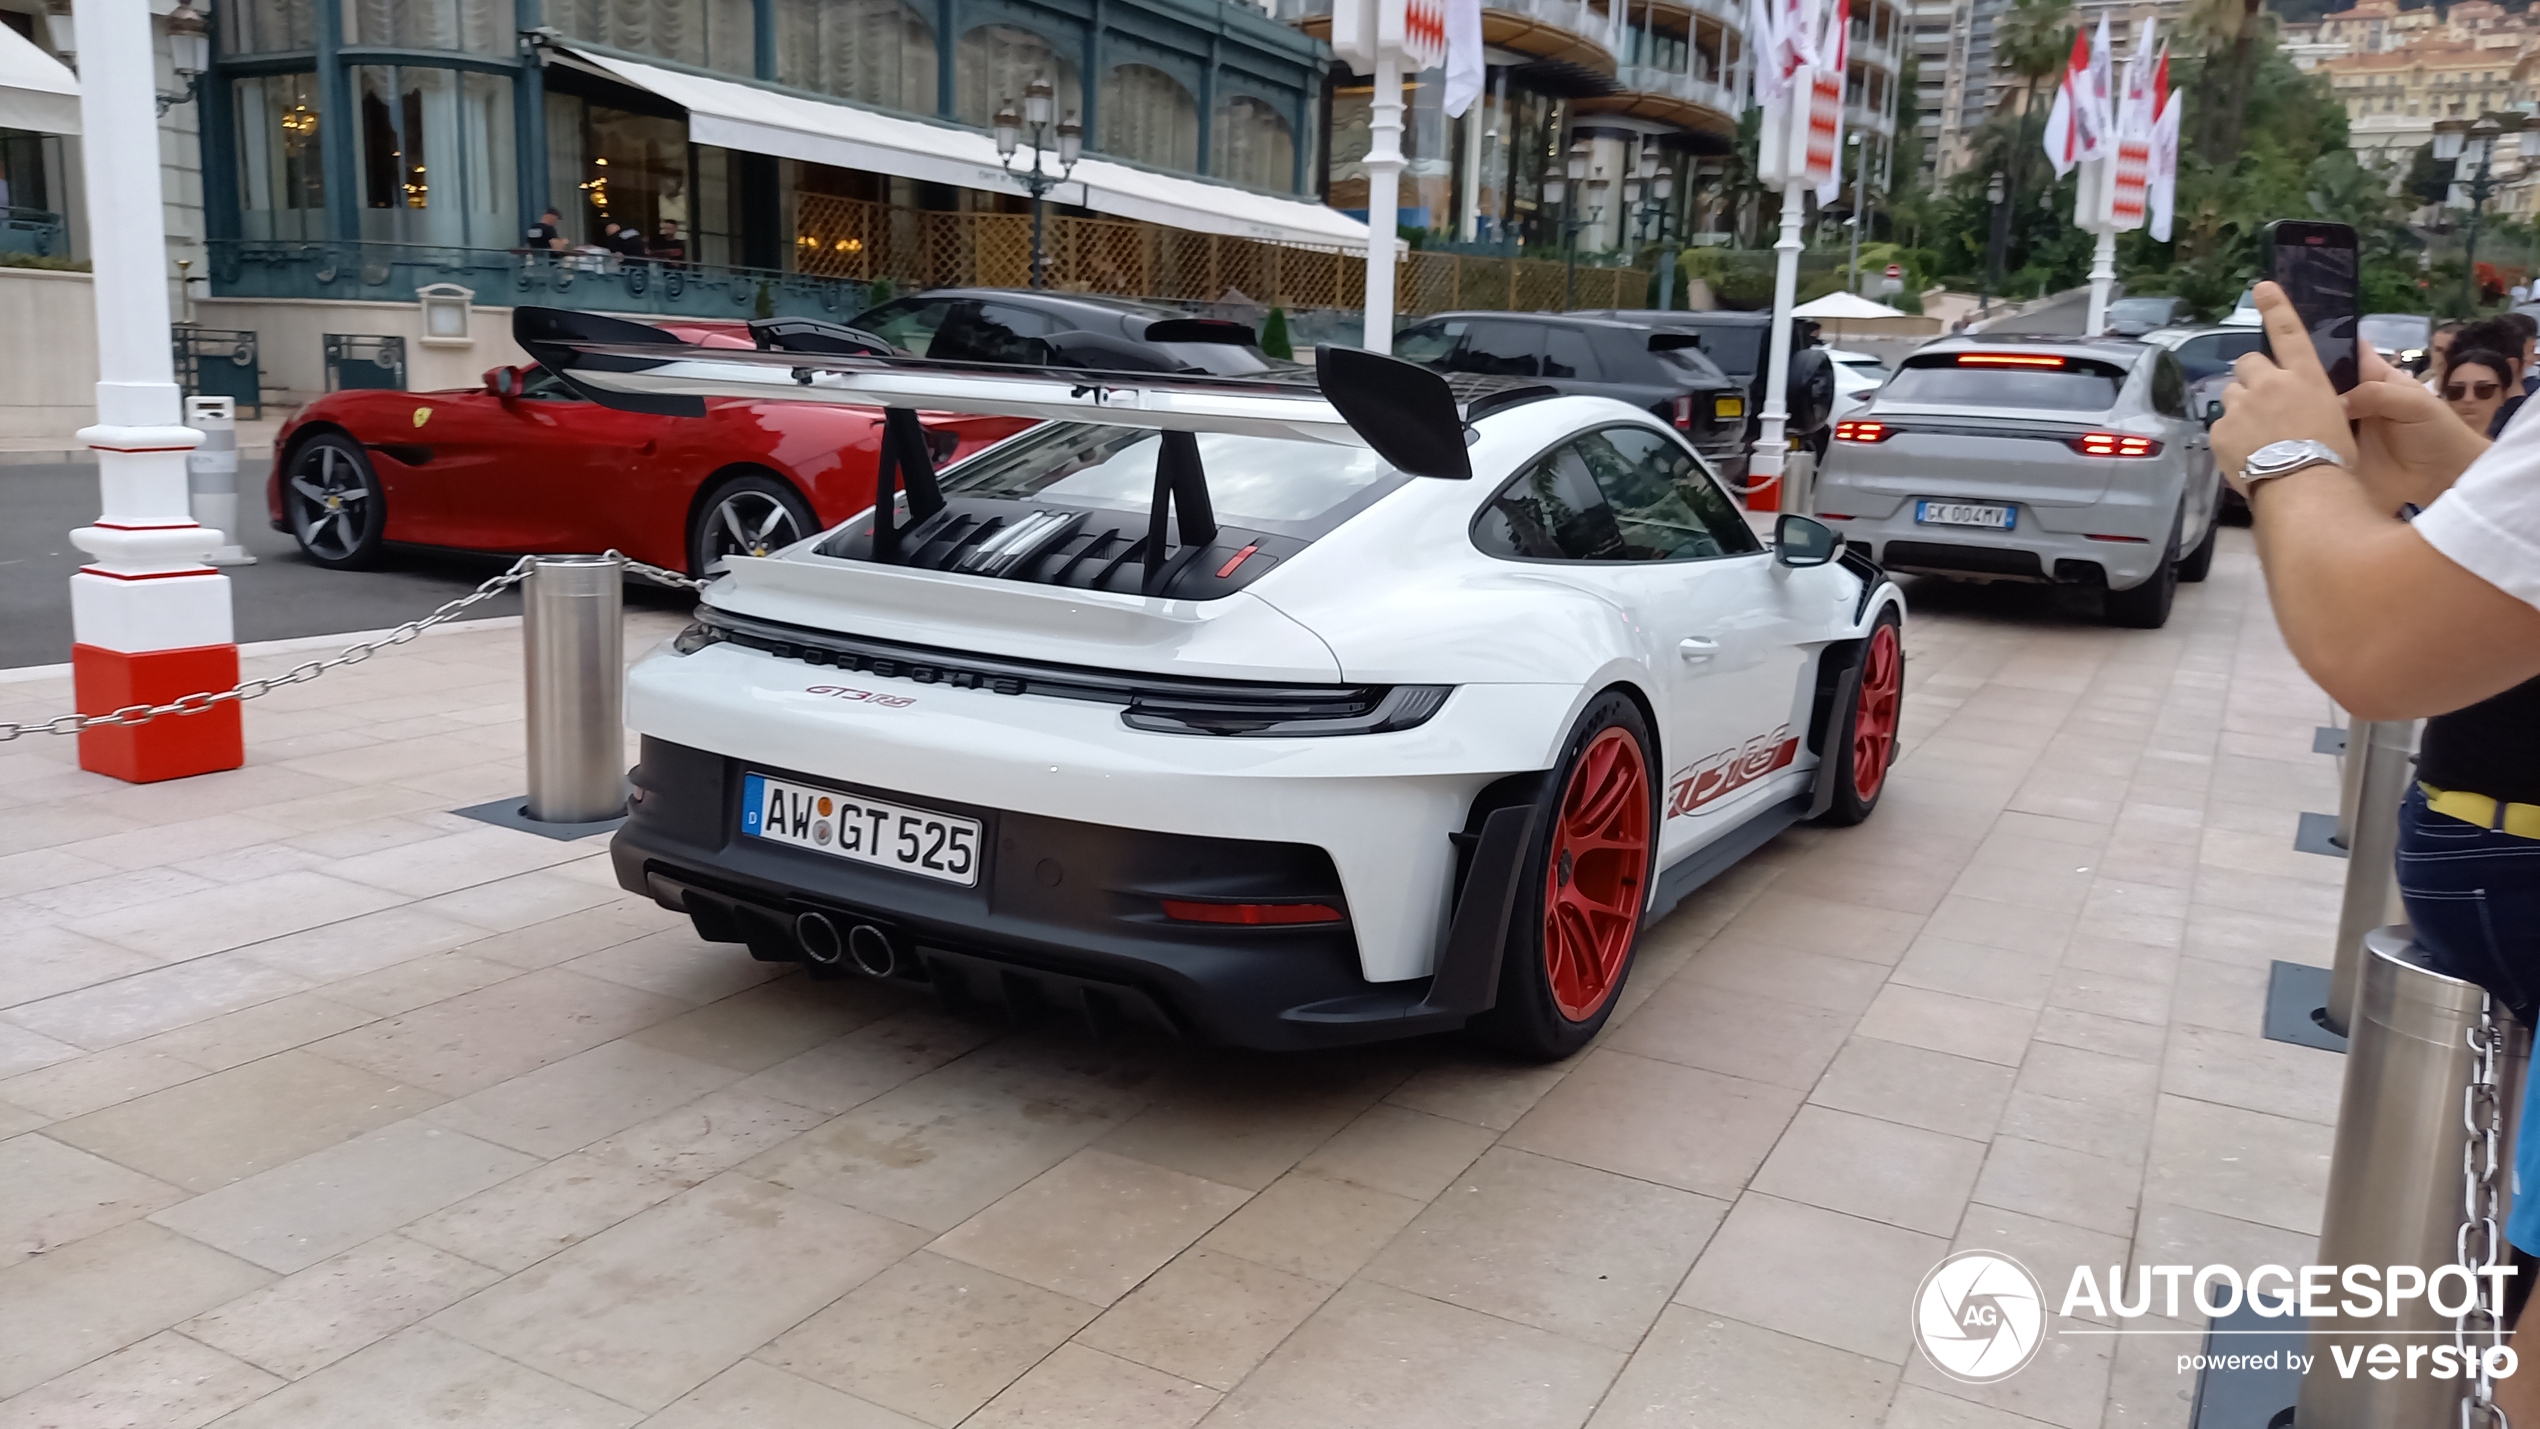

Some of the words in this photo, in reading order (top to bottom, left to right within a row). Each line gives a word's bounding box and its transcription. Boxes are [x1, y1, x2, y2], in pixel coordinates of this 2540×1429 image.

[765, 788, 814, 840] AW
[838, 803, 890, 856] GT
[897, 815, 974, 875] 525
